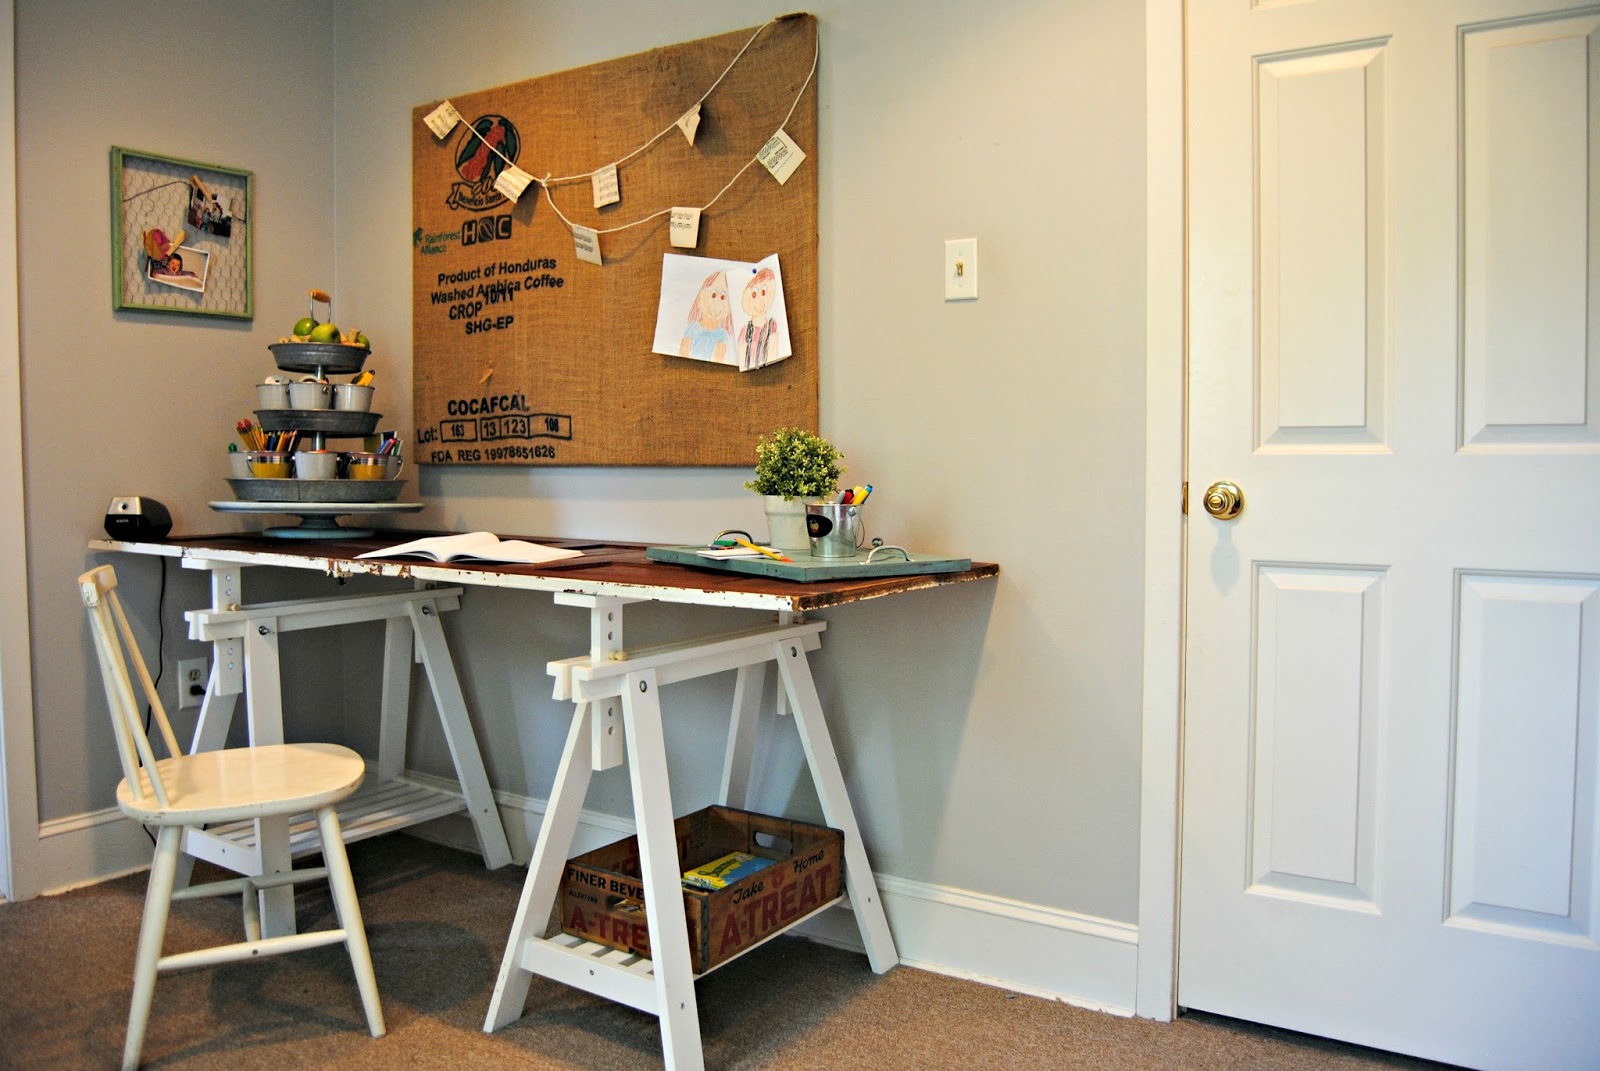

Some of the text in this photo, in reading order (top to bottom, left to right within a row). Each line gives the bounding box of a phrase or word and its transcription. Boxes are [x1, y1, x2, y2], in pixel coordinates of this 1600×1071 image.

[421, 244, 447, 255] Alliance
[438, 258, 556, 286] Product of Honduras
[431, 275, 564, 304] Washed Arabica Coffee
[449, 302, 483, 320] CROP
[465, 315, 514, 335] SHG-EP
[447, 394, 530, 416] COCAFCAL
[417, 427, 438, 444] Lot:
[483, 421, 497, 437] 13
[504, 419, 526, 434] 123
[431, 450, 453, 464] FDA
[458, 449, 481, 462] REG
[567, 868, 606, 890] FINER
[733, 850, 824, 904] Take Home
[719, 863, 832, 957] A-TREAT
[570, 906, 651, 952] A-TRE
